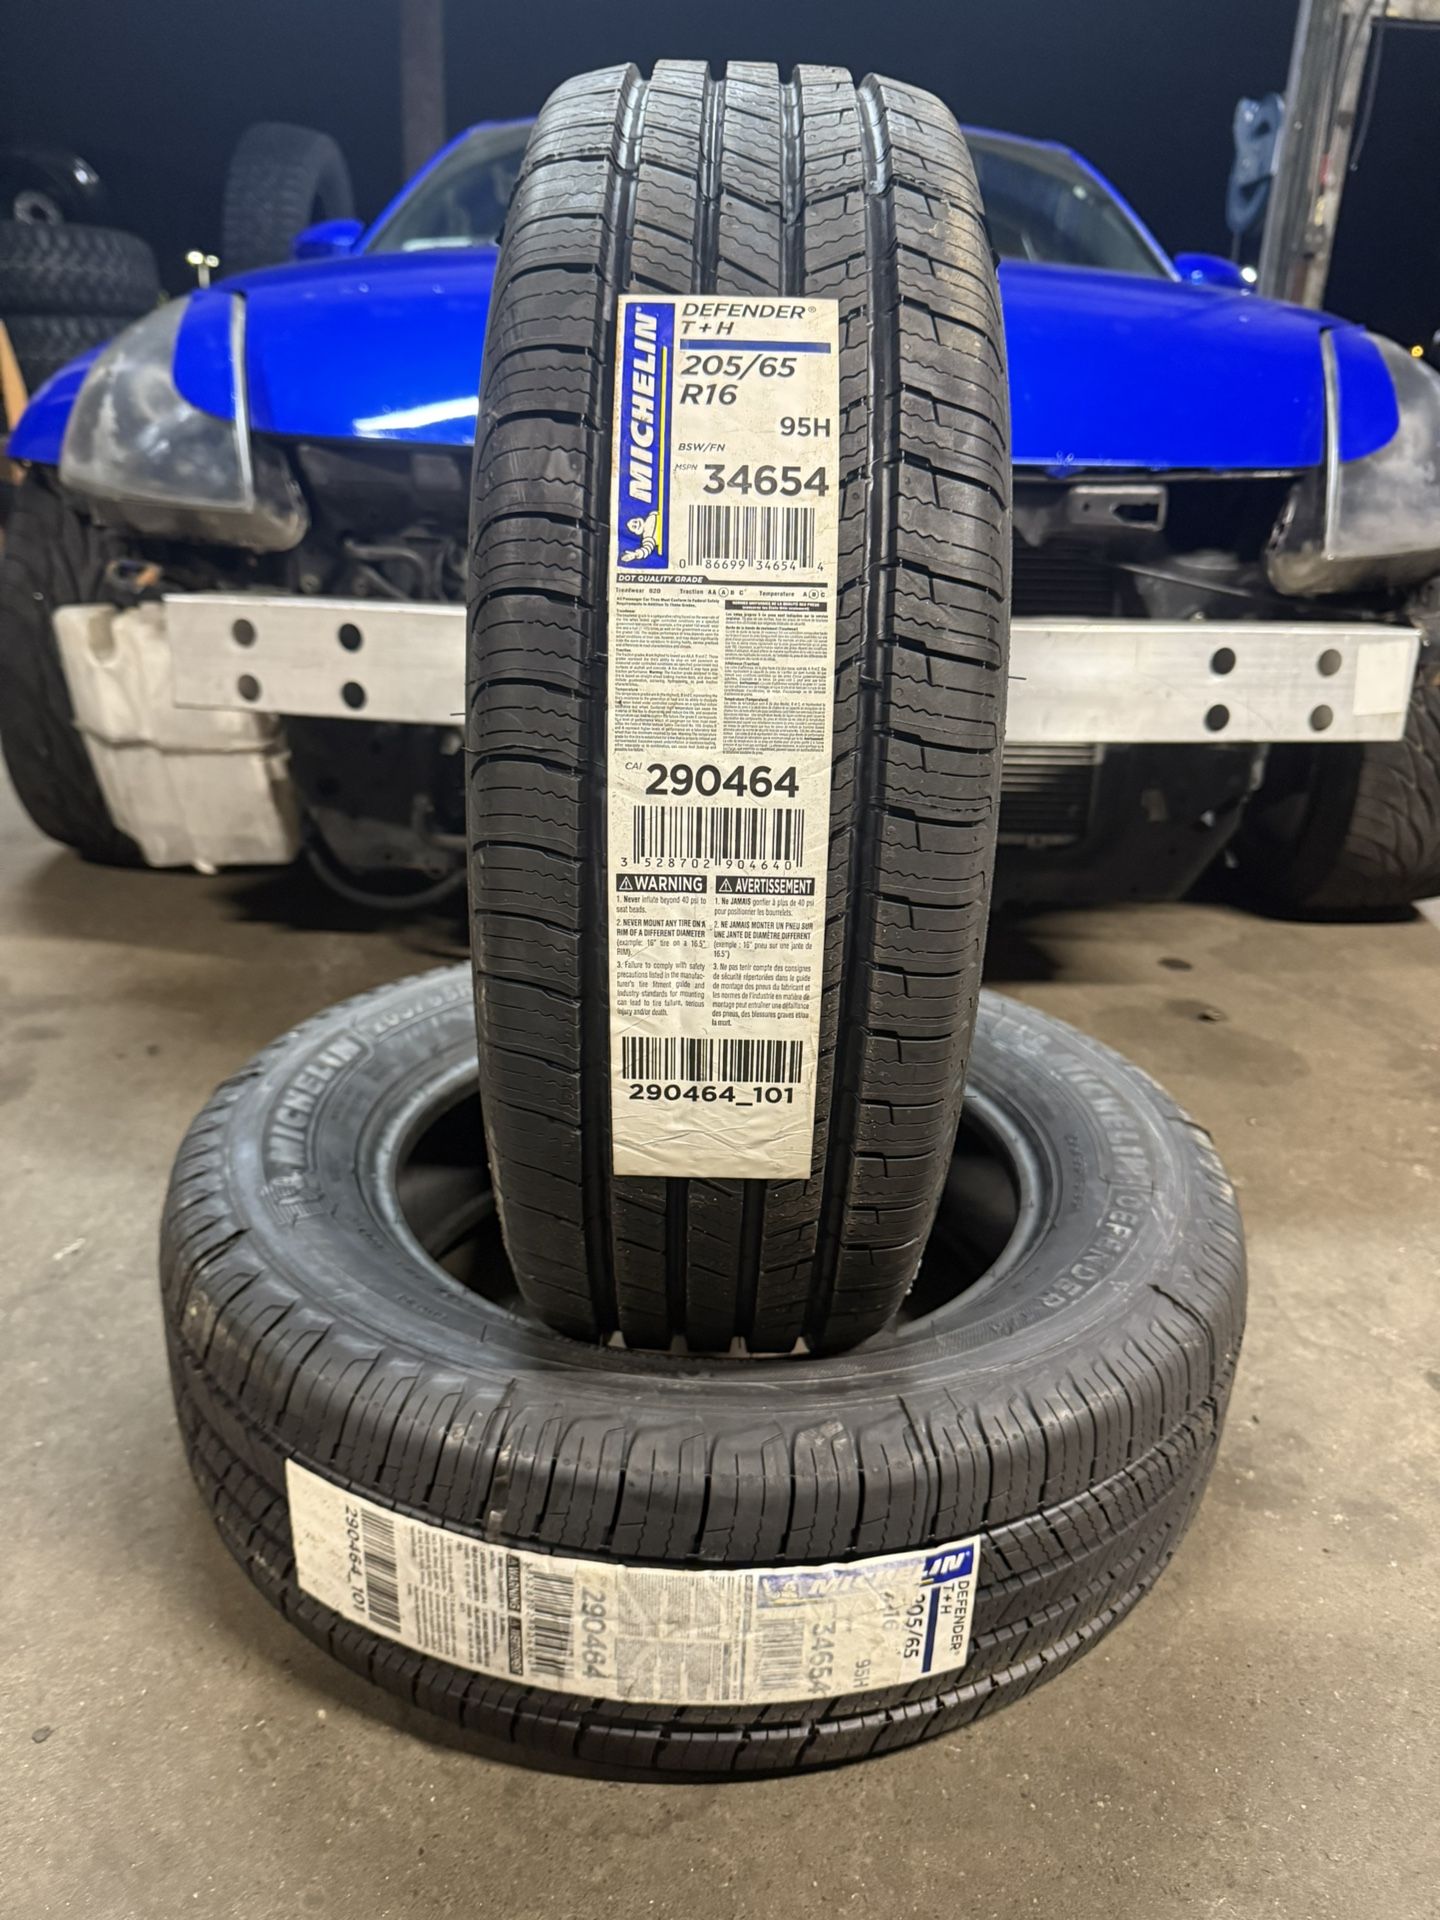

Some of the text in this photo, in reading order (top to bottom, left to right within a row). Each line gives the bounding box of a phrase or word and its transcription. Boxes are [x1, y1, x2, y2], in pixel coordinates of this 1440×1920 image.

[680, 354, 797, 380] 205/65
[680, 384, 738, 405] R16
[780, 417, 830, 437] 95H
[679, 442, 725, 452] BSW/FN
[703, 464, 829, 496] 34654
[705, 560, 746, 570] 86699
[756, 561, 796, 570] 34654
[646, 763, 799, 797] 290464
[634, 876, 702, 891] WARNING
[736, 878, 812, 893] AVERTISSEMENT
[660, 896, 680, 905] beyond
[629, 1084, 793, 1106] 290464_101
[1042, 1194, 1146, 1306] DEFENDER
[346, 1504, 367, 1613] 290464_101
[581, 1586, 611, 1679] 290464
[808, 1620, 837, 1694] 34654
[853, 1659, 871, 1688] 95H
